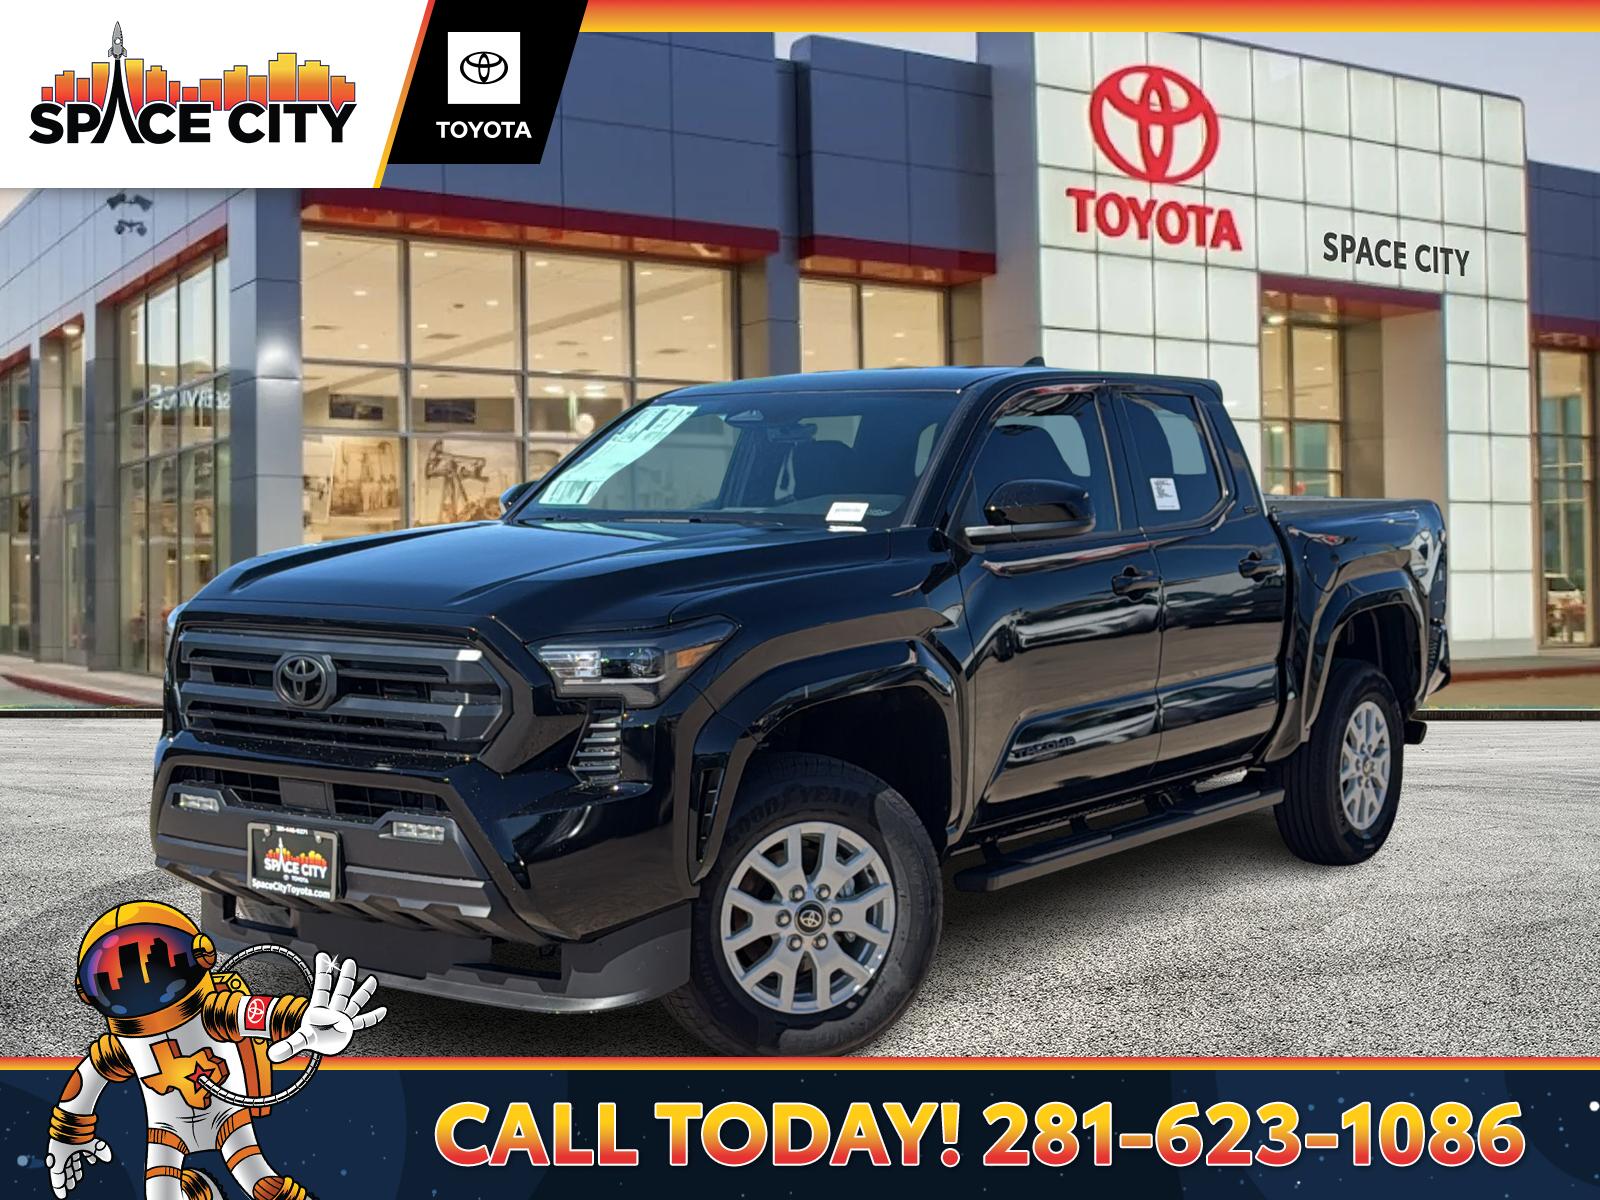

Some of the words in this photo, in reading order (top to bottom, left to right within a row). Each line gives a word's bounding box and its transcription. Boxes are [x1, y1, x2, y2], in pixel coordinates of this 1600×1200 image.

[1066, 187, 1242, 251] TOYOTA
[1323, 232, 1407, 270] SPACE
[1415, 244, 1470, 277] CITY
[264, 856, 300, 874] SPACE
[301, 863, 328, 879] CITY
[251, 878, 331, 899] SpaceCityToyota.com
